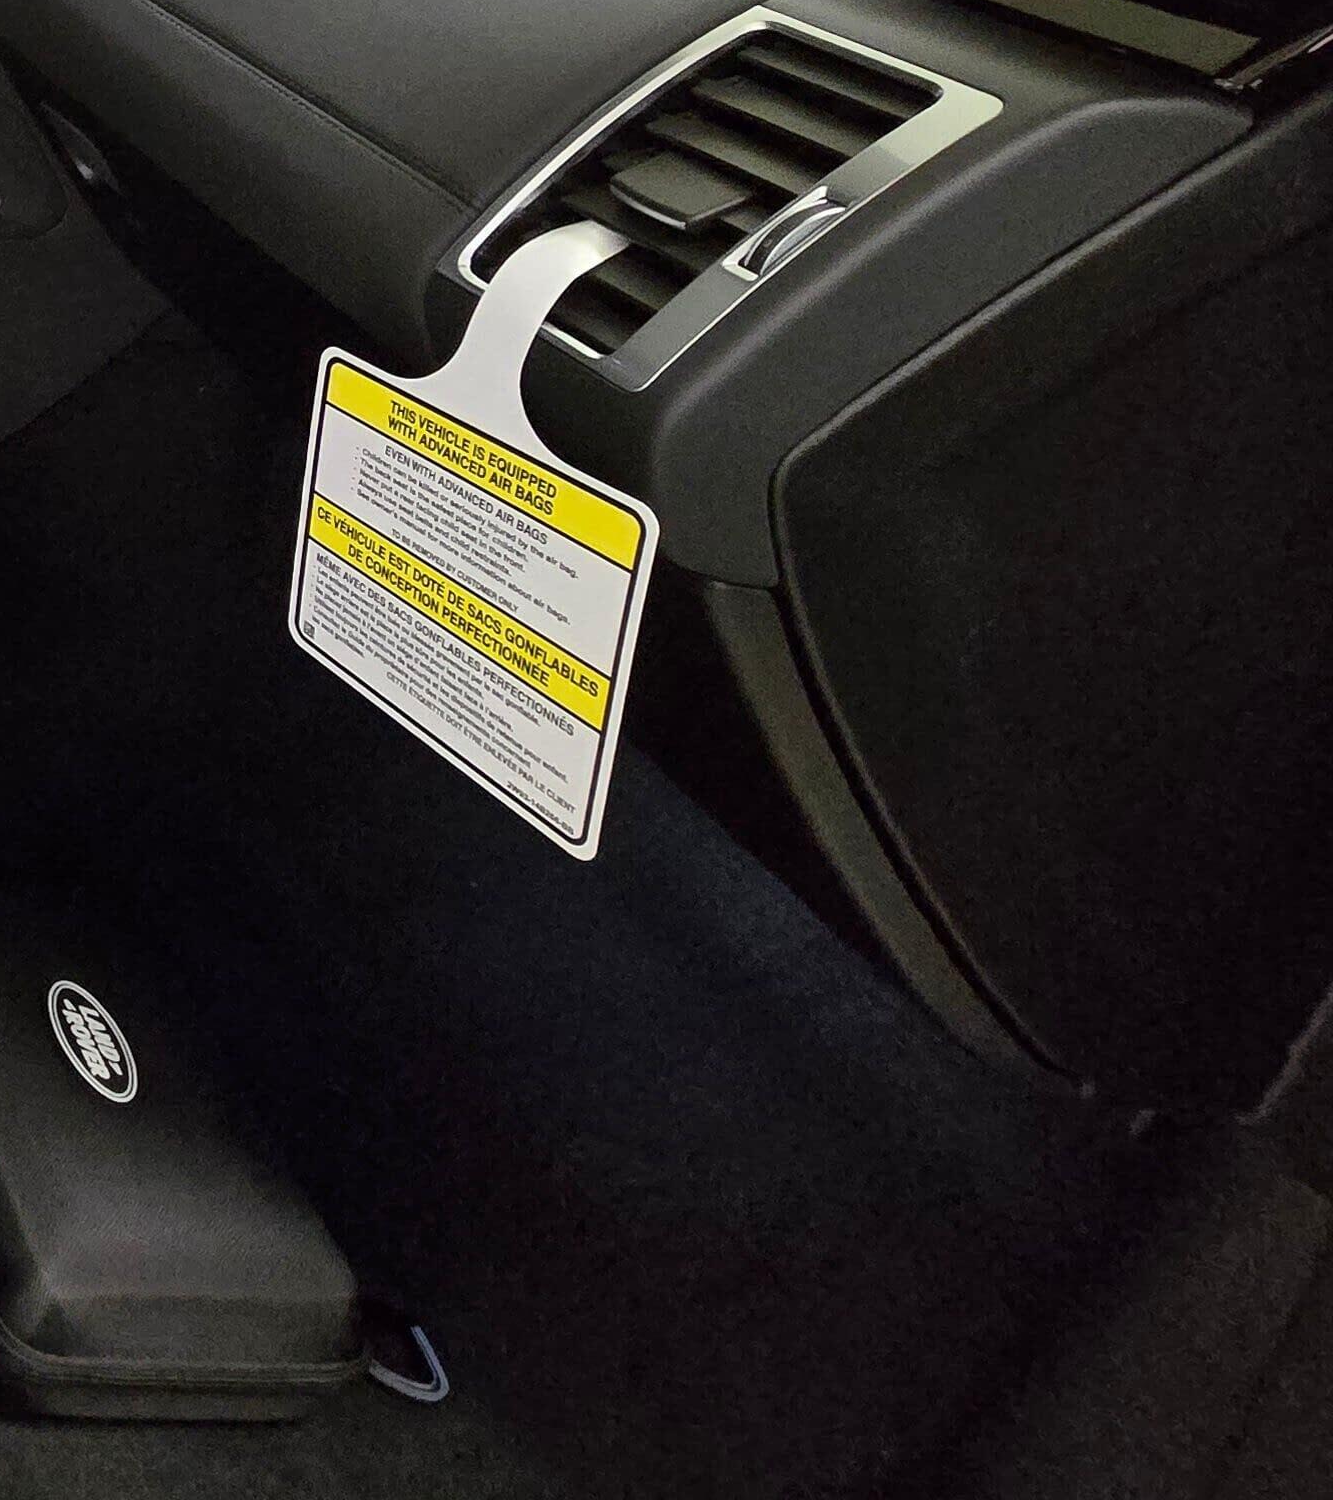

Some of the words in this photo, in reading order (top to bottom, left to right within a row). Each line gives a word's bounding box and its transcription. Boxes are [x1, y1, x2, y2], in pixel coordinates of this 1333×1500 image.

[384, 445, 410, 467] EVEN
[411, 459, 436, 481] WITH
[437, 475, 493, 513] ADVANCED
[494, 508, 514, 526] AIR
[515, 519, 547, 544] BAGS
[387, 414, 417, 441] WITH
[418, 433, 486, 478] ADVANCED
[488, 471, 512, 493] AIR
[514, 484, 553, 515] BAGS
[391, 399, 416, 424] THIS
[418, 414, 470, 453] VEHICLE
[472, 443, 485, 460] IS
[487, 451, 556, 498] EQUIPPED
[316, 552, 341, 576] MÊME
[342, 571, 366, 593] AVEC
[367, 587, 385, 607] DES
[387, 601, 412, 625] SACS
[414, 620, 480, 672] GONFLABLES
[482, 666, 574, 736] PERFECTIONNÉS
[317, 506, 331, 524] CE
[333, 515, 386, 560] VÉHICULE
[388, 551, 411, 575] EST
[412, 567, 445, 598] DOTÉ
[447, 589, 465, 611] DE
[466, 602, 502, 634] SACS
[504, 627, 598, 697] GONFLABLES
[347, 543, 363, 563] DE
[365, 555, 439, 613] CONCEPTION
[441, 605, 549, 687] PERFECTIONNÉE
[62, 1009, 111, 1080] ROVER
[79, 1005, 121, 1062] LAND
